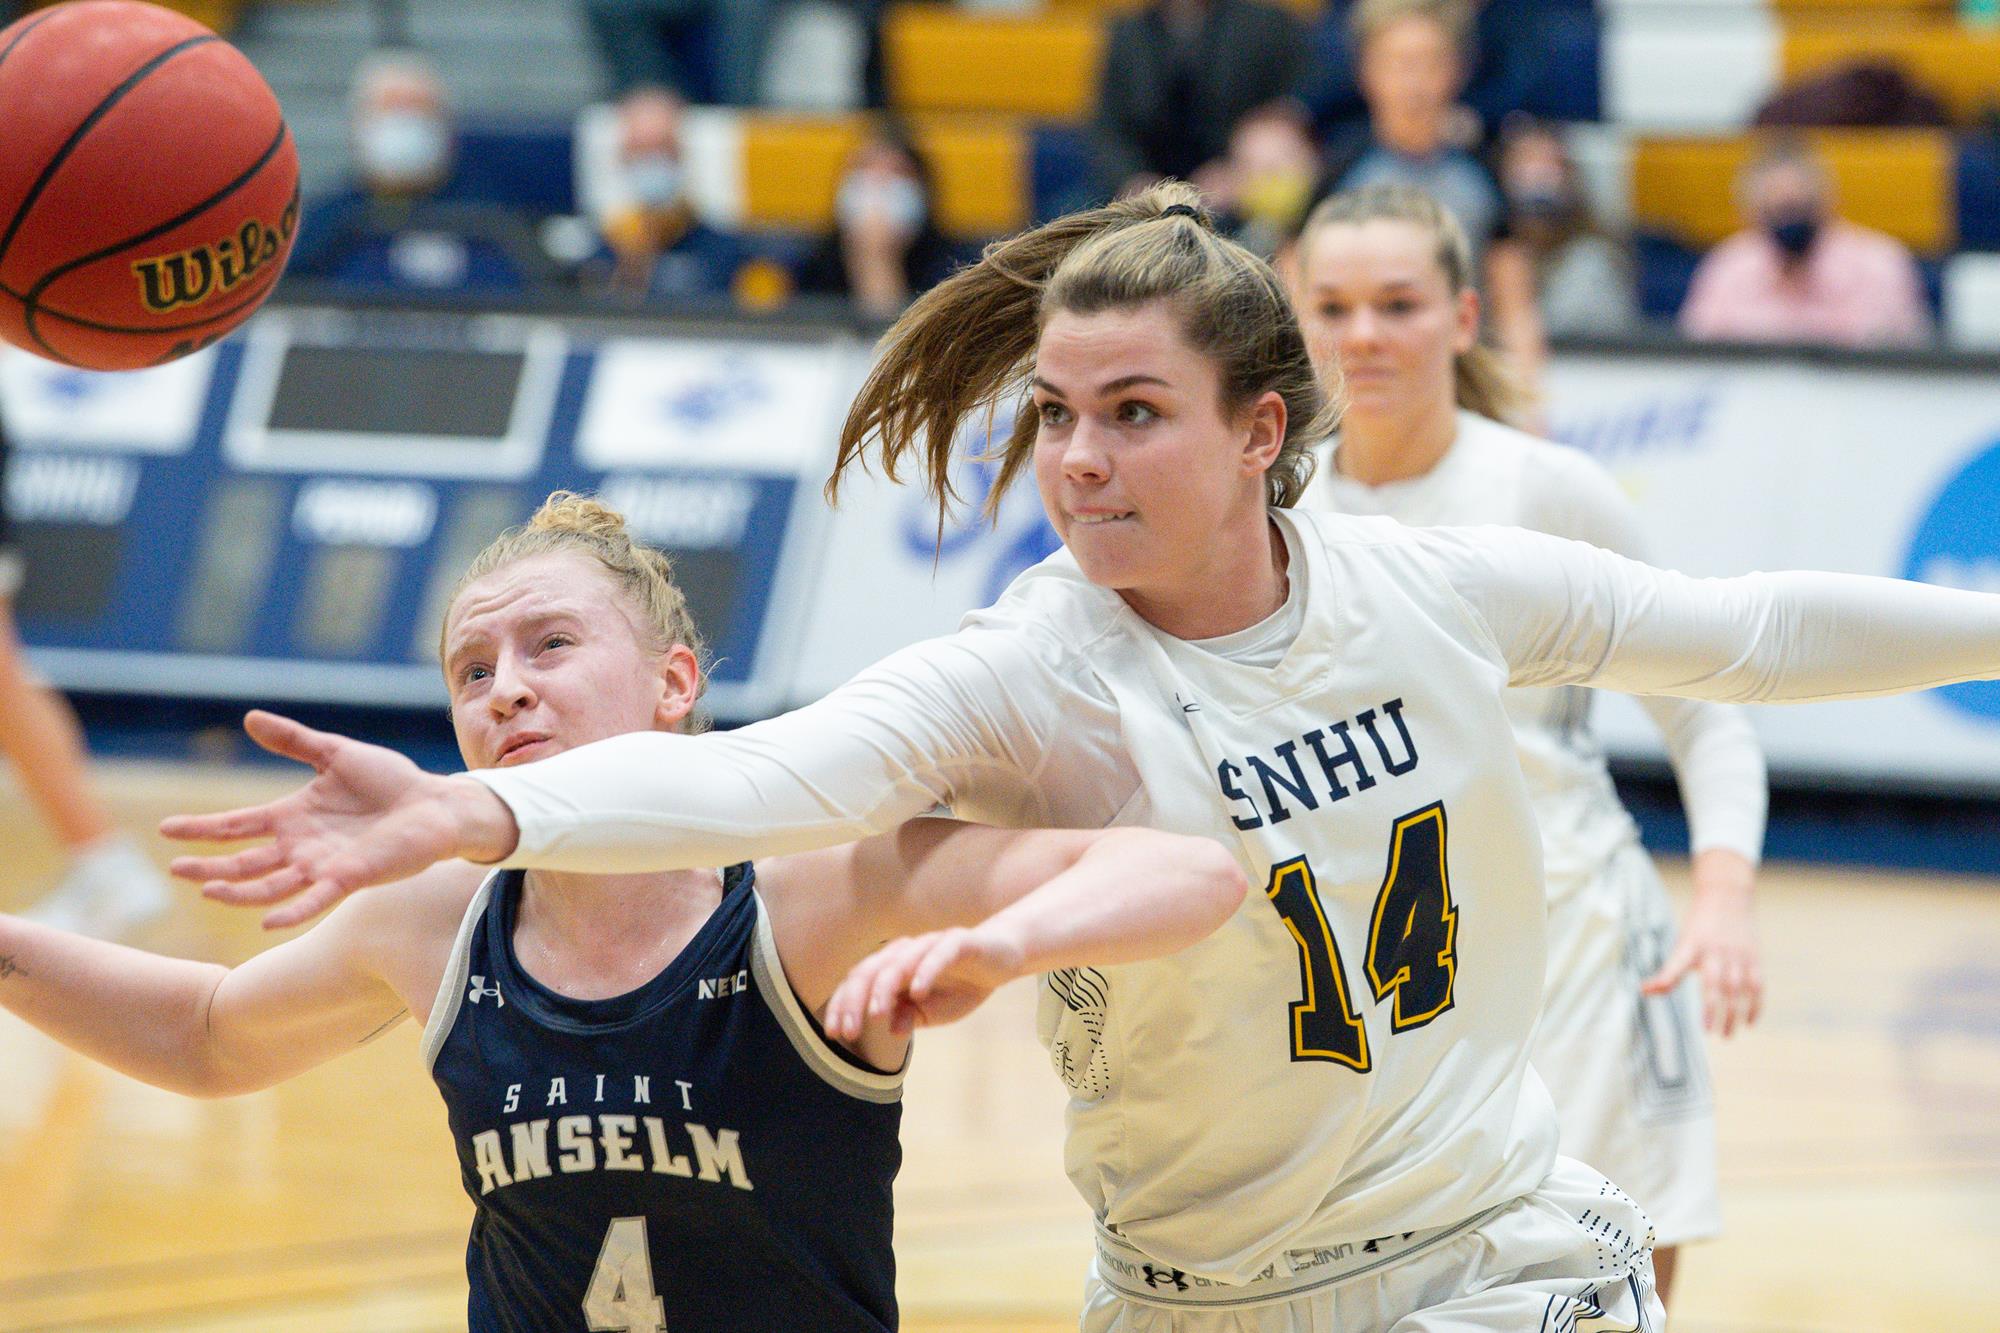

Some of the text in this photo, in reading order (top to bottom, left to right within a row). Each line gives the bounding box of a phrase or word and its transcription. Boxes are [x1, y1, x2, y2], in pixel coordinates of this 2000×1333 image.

[132, 195, 299, 313] Wilso
[1217, 697, 1419, 832] SNHU
[1265, 800, 1459, 1074] 14
[503, 1074, 692, 1114] SAINT
[472, 1113, 754, 1196] ANSELM
[581, 1215, 668, 1333] 4
